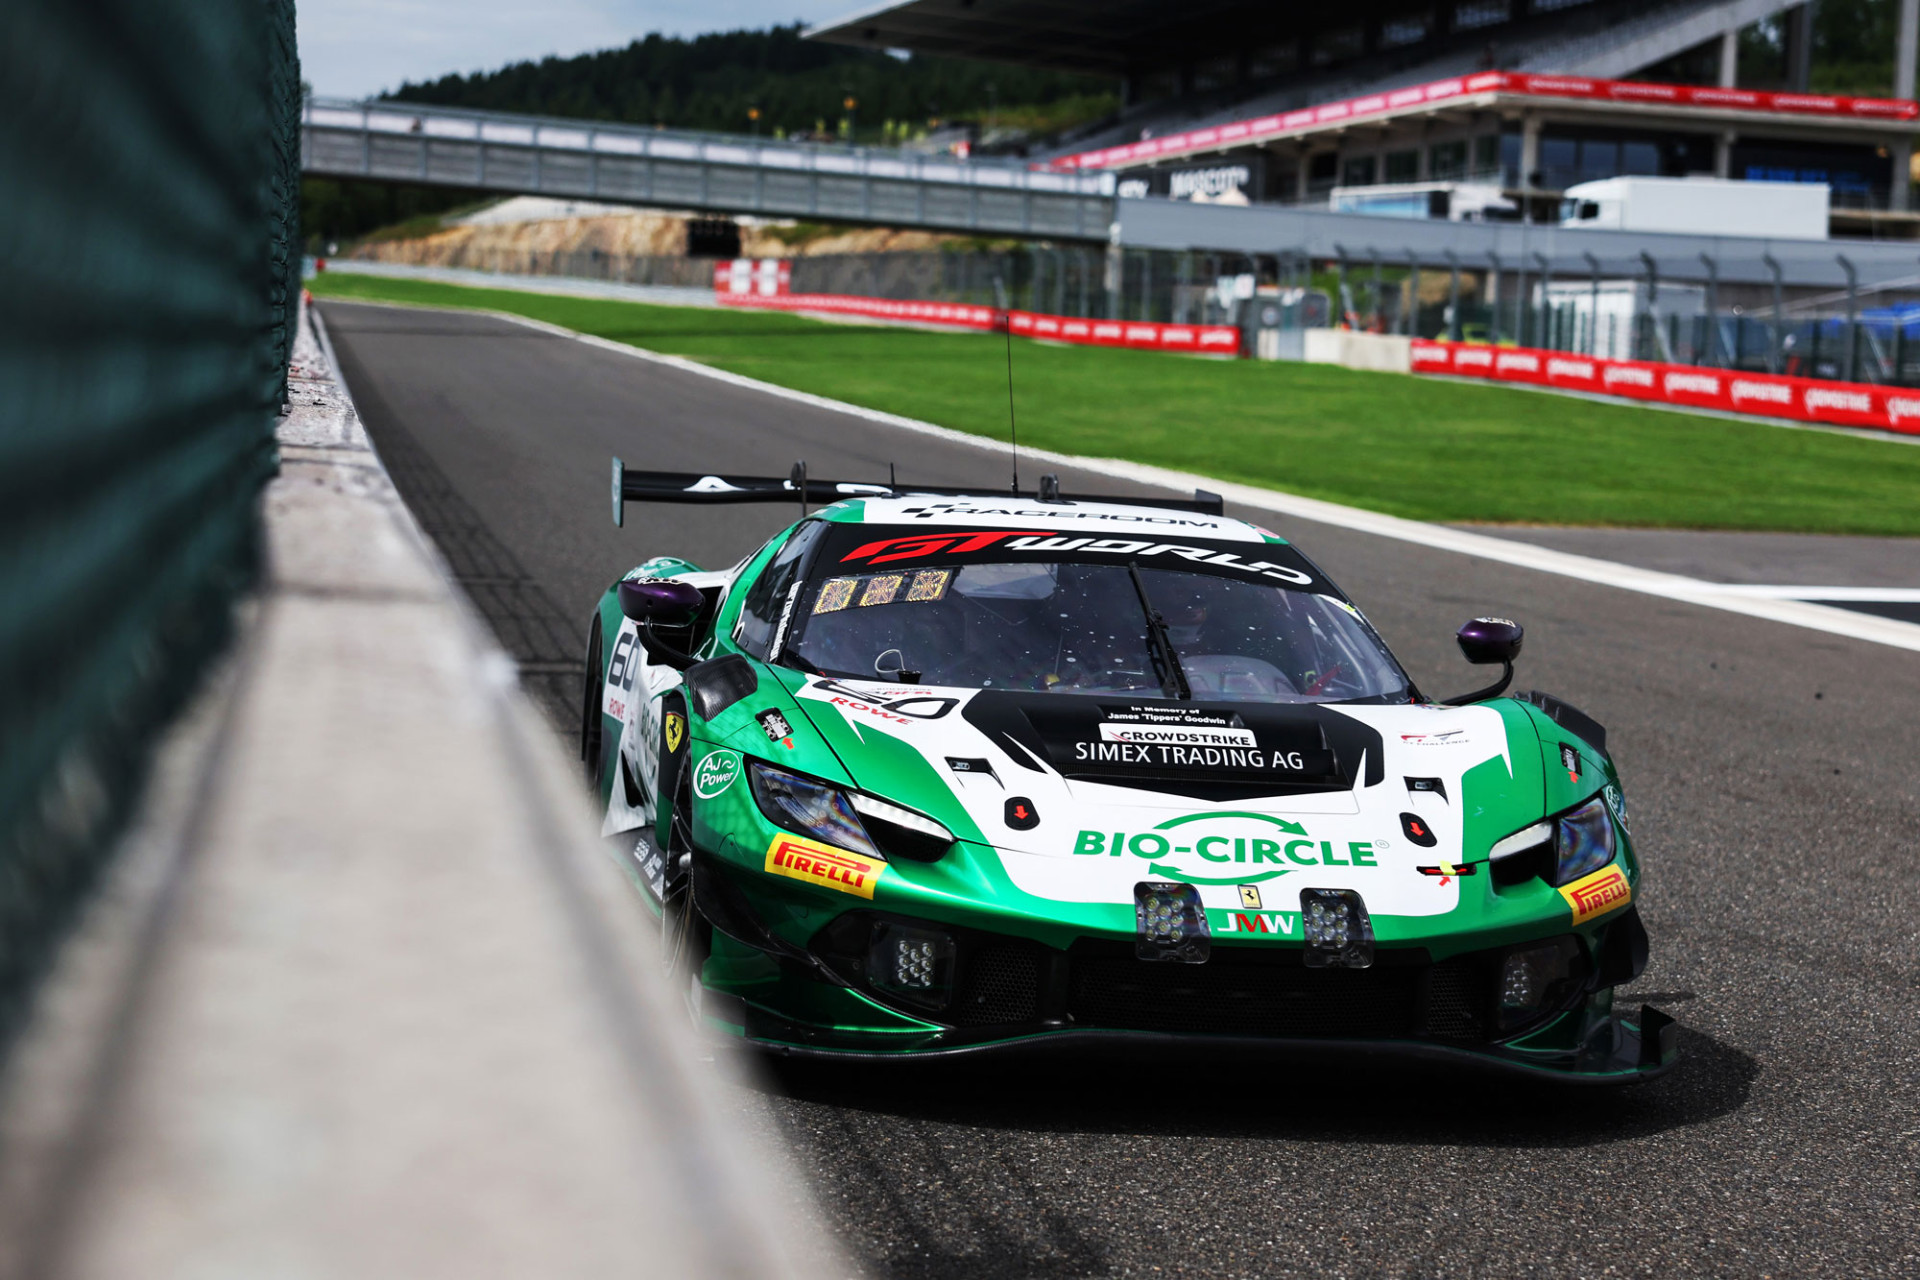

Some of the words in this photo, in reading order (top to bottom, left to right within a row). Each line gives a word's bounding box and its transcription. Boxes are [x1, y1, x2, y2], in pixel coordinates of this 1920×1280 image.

[943, 507, 1219, 529] RACEROOM
[840, 531, 1058, 565] GT
[1003, 536, 1313, 585] WORLD
[829, 696, 914, 726] ROWE
[1107, 712, 1140, 720] James
[1184, 715, 1226, 725] Goodwin
[1143, 706, 1187, 715] Memory
[1119, 731, 1251, 746] CROWDSTRIKE
[702, 757, 722, 772] AJ
[1075, 741, 1152, 763] SIMEX
[1157, 745, 1265, 768] TRADING
[1271, 750, 1304, 770] AG
[700, 772, 734, 789] Power
[1072, 829, 1379, 867] BIO-CIRCLE
[773, 841, 872, 888] PIRELLI
[1570, 872, 1629, 916] PIRELLI
[1216, 912, 1295, 935] JMW
